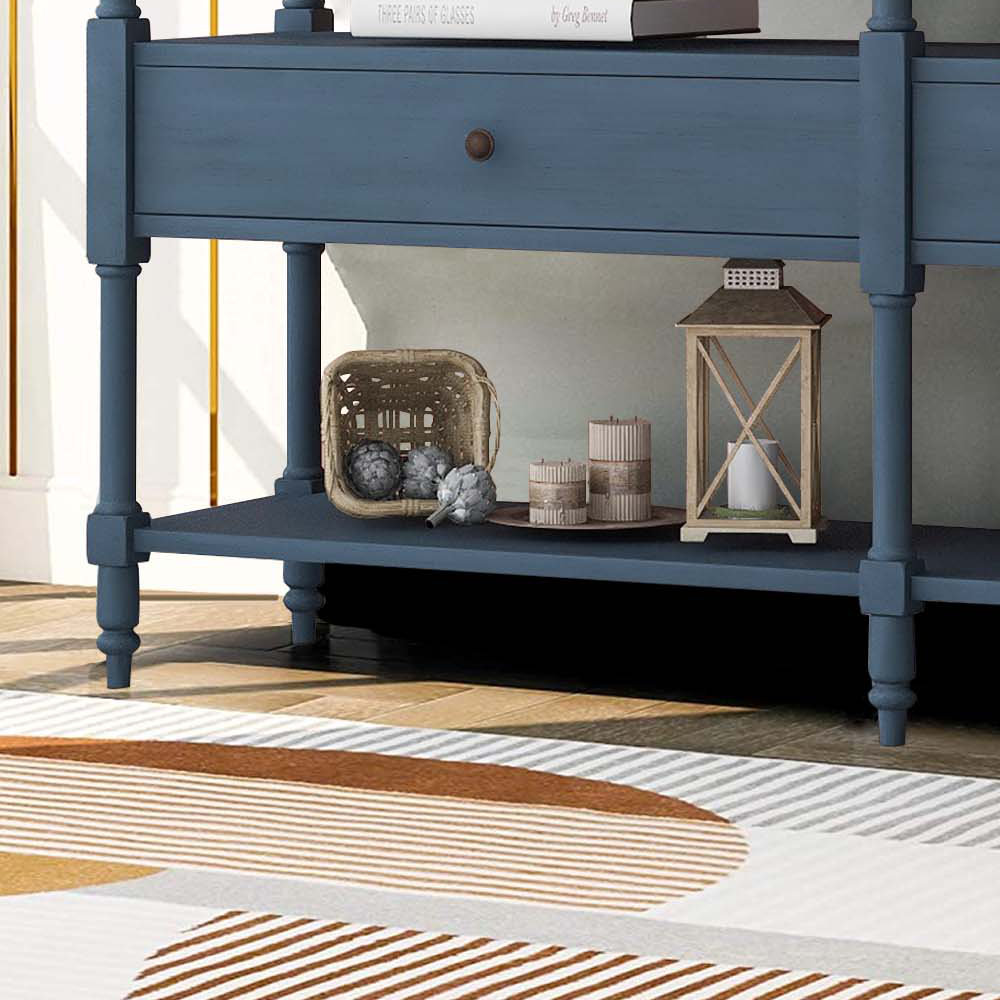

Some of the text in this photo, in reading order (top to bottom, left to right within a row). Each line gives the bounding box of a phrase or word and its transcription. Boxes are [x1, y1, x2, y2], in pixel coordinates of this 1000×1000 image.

[378, 4, 402, 24] THREE
[404, 4, 426, 24] PAIRS
[428, 5, 438, 24] OF
[440, 5, 475, 25] GLASSES
[551, 6, 560, 27] by
[561, 6, 580, 29] Greg
